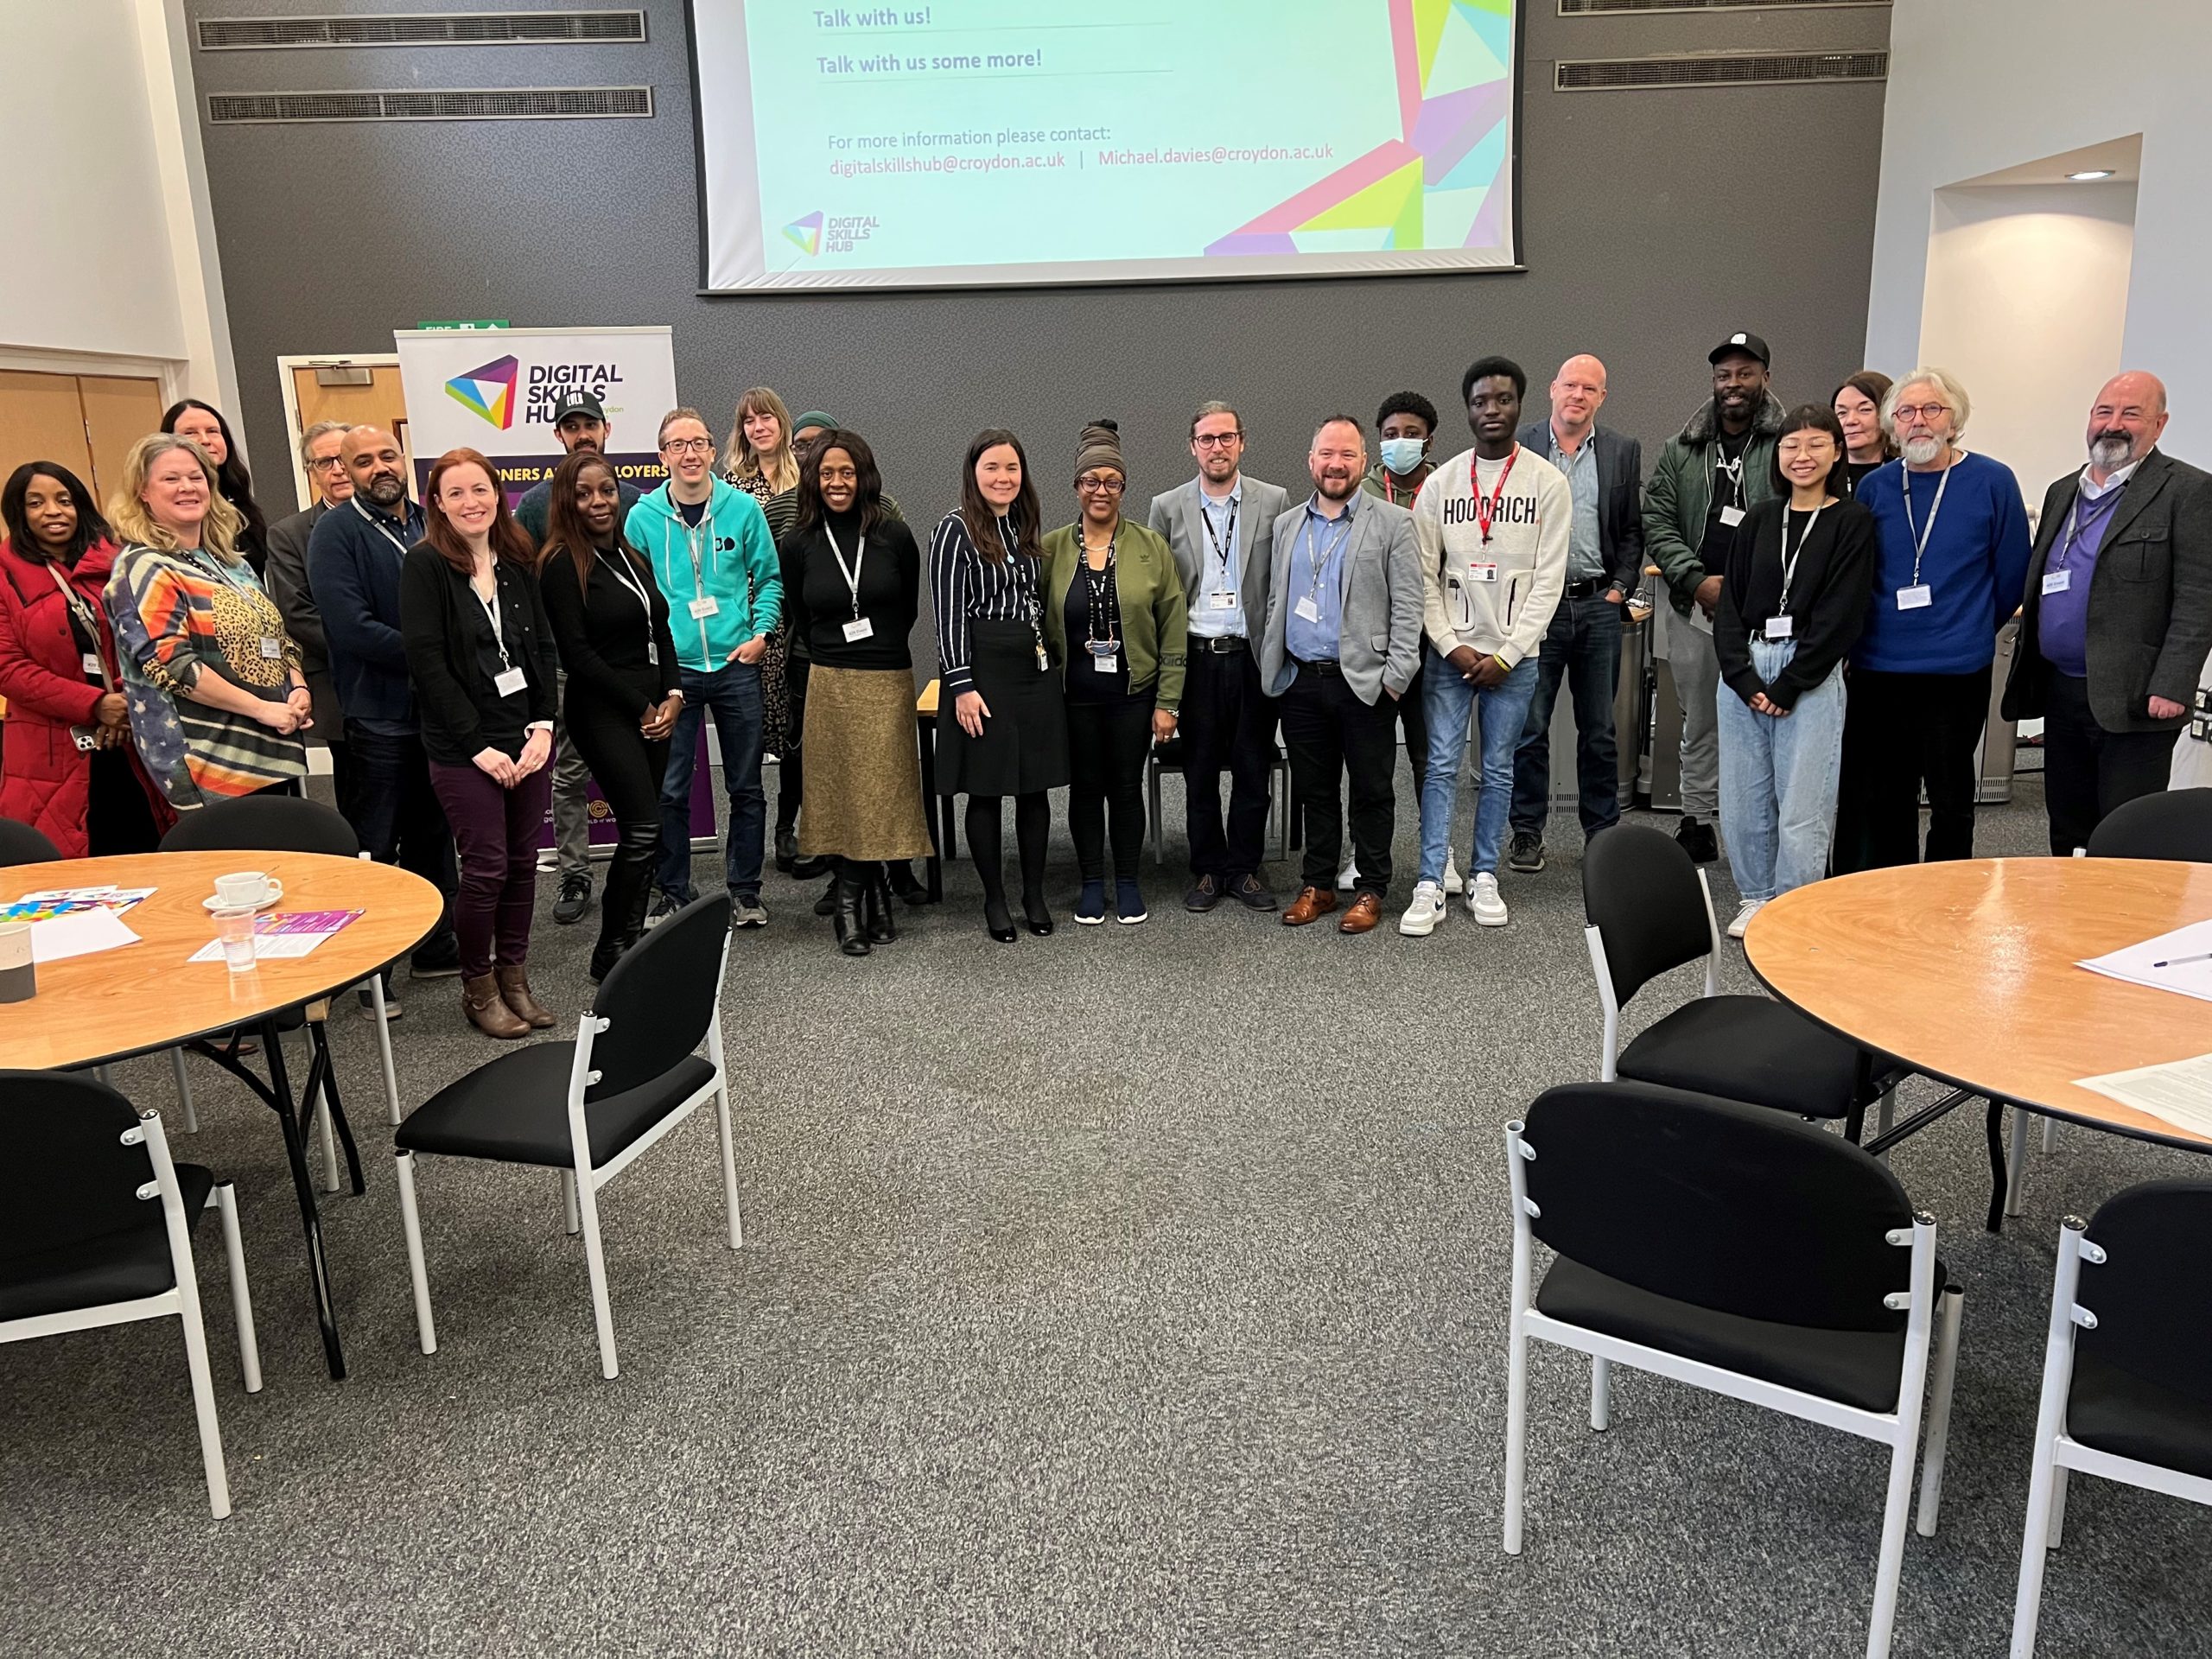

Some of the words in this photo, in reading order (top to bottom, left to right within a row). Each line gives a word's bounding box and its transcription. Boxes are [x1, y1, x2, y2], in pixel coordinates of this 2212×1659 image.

[813, 10, 851, 28] Talk
[856, 8, 898, 26] with
[904, 6, 931, 24] us!
[817, 55, 855, 73] Talk
[859, 54, 900, 73] with
[906, 58, 926, 70] us
[932, 55, 982, 69] some
[987, 48, 1042, 68] more!
[829, 136, 852, 149] For
[857, 135, 898, 149] more
[902, 130, 992, 147] information
[997, 128, 1046, 147] please
[1050, 126, 1111, 143] contact:
[830, 151, 1065, 178] digitalskillshub@croydon.ac.uk
[1098, 143, 1333, 165] Michael.davies@croydon.ac.uk
[828, 216, 880, 229] DIGITAL
[827, 228, 870, 240] SKILLS
[825, 240, 854, 252] HUB
[529, 365, 623, 384] DIGITAL
[525, 405, 556, 423] HU
[495, 467, 540, 481] NERS
[614, 465, 669, 479] LOYERS
